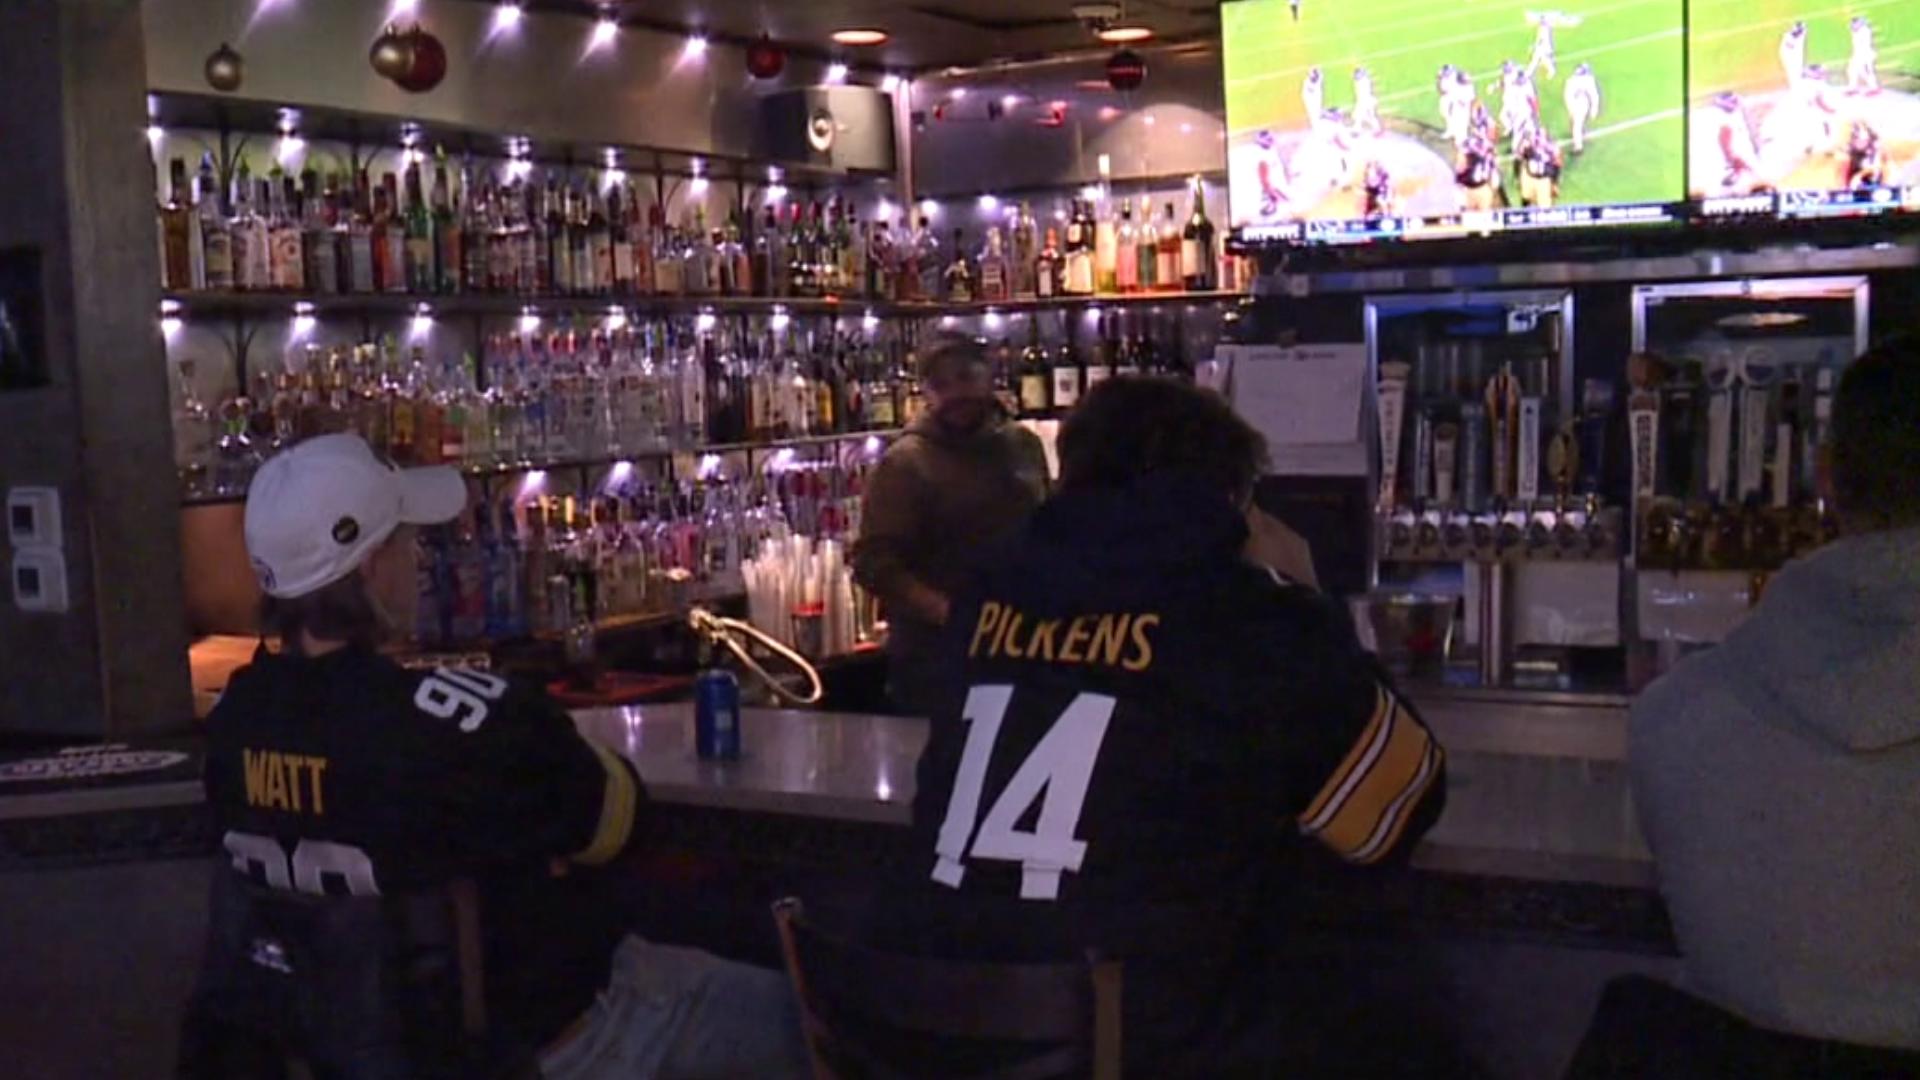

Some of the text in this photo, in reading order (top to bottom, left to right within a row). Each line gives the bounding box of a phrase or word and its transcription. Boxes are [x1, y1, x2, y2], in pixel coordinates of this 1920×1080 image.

[967, 600, 1162, 672] PICKENS
[412, 665, 509, 733] 90
[242, 746, 328, 816] WATT
[930, 683, 1118, 901] 14
